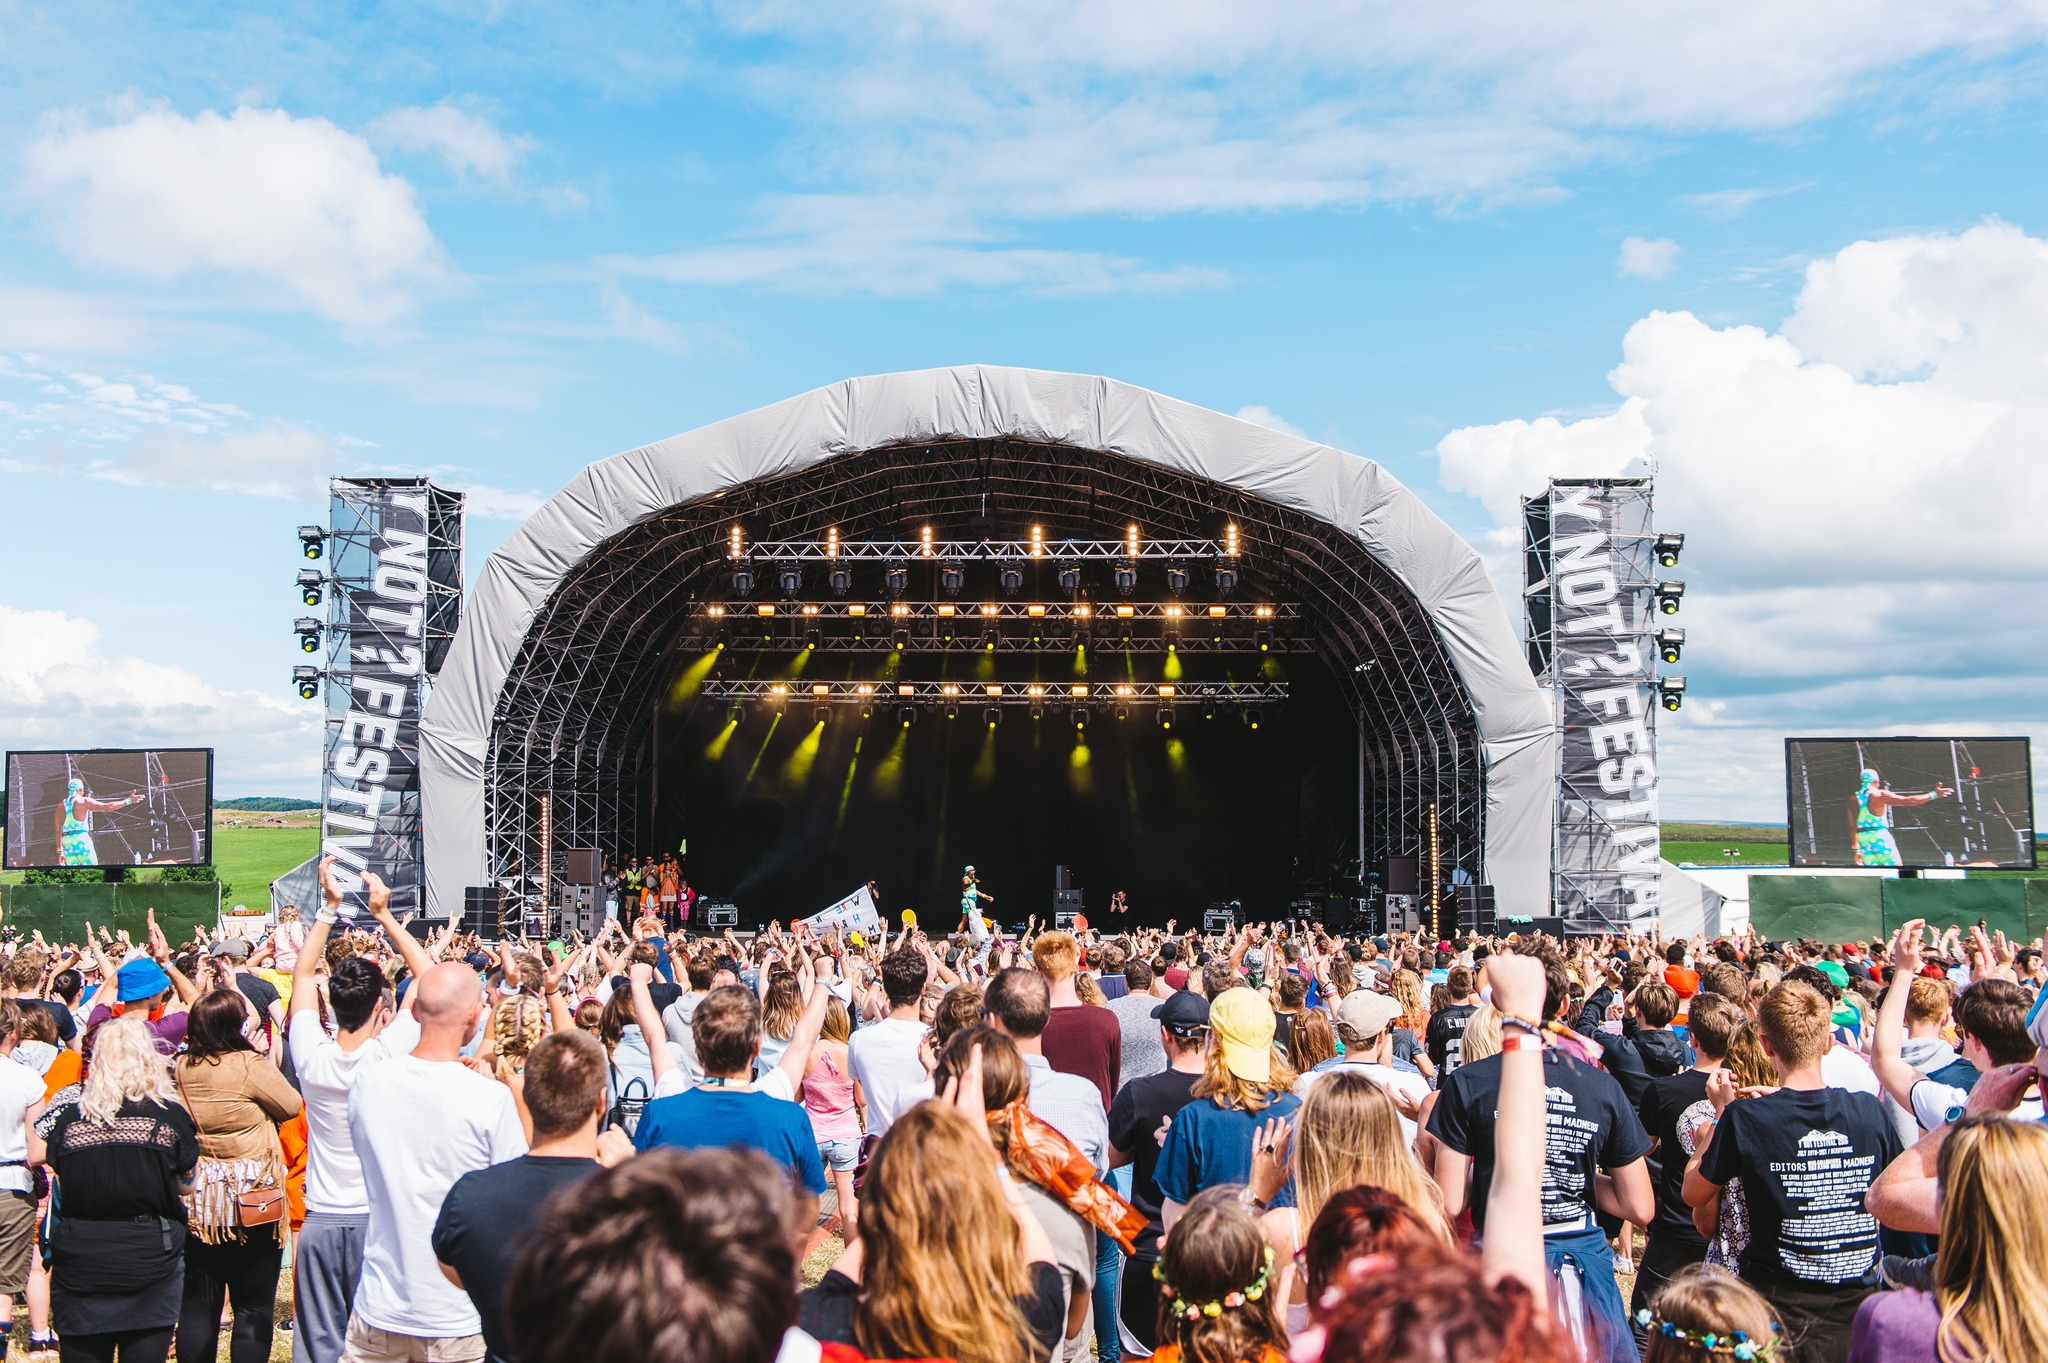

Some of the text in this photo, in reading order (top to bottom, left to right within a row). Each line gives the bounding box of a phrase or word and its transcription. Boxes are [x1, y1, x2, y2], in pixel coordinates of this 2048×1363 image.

[391, 493, 426, 520] Y
[1554, 488, 1604, 522] Y
[1563, 1116, 1599, 1132] MADNESS
[1813, 1139, 1838, 1148] FESTIVAL
[1770, 1162, 1807, 1172] EDITORS
[1843, 1155, 1876, 1169] MADNESS
